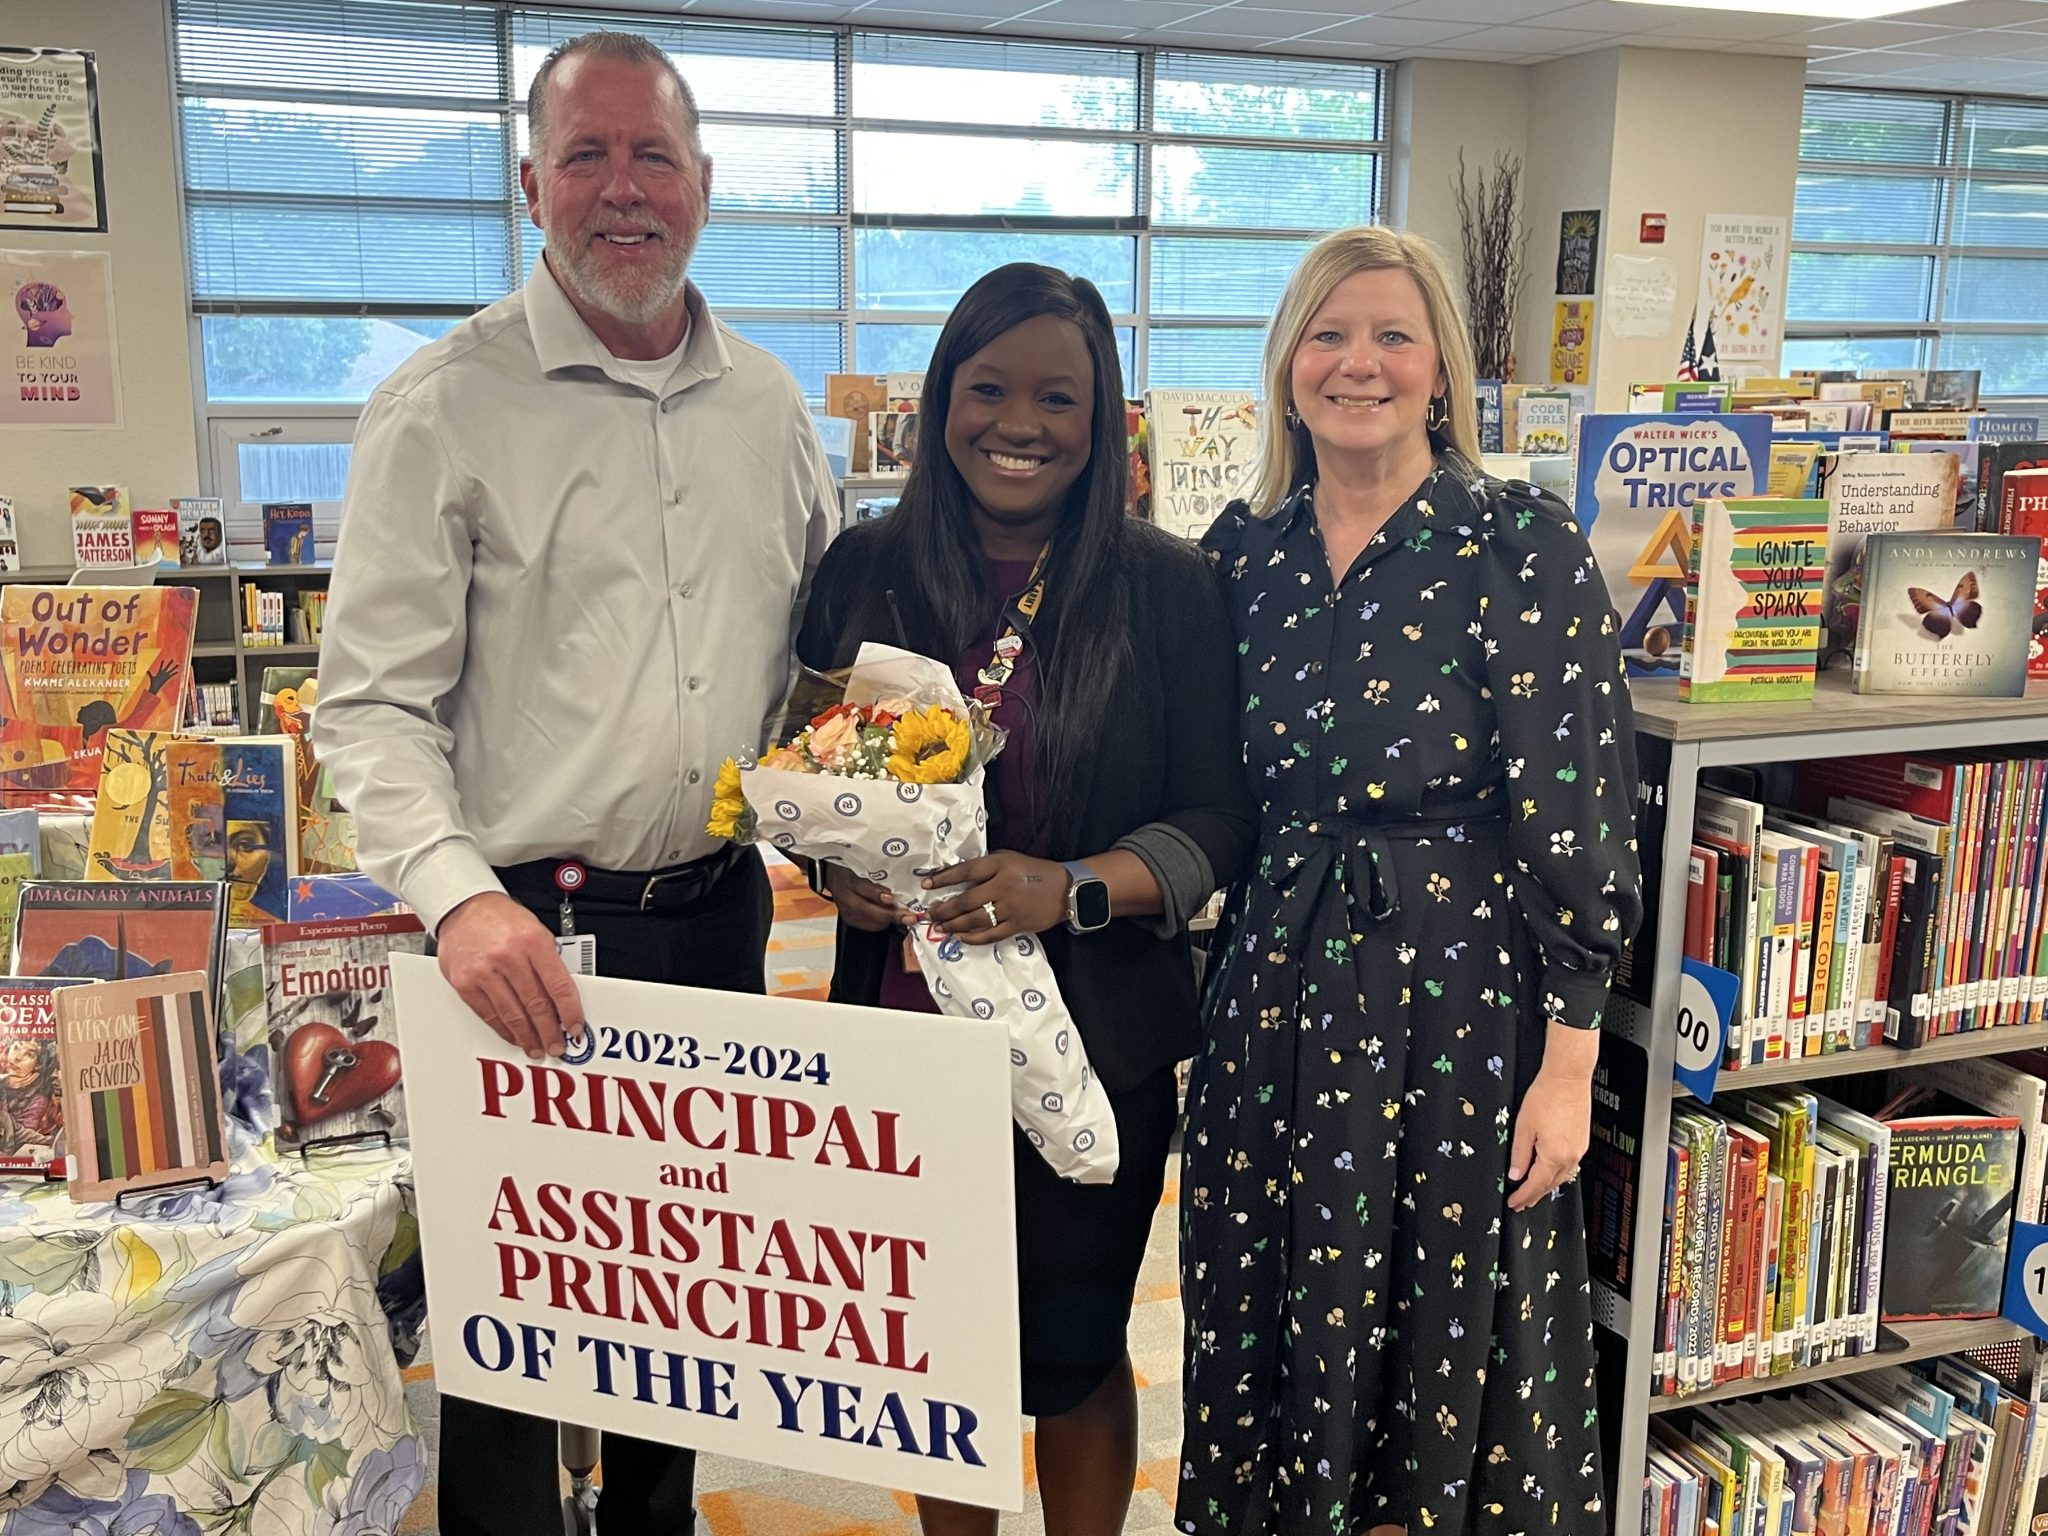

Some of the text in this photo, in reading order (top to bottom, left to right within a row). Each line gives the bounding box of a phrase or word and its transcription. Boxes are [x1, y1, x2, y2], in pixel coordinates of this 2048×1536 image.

[25, 69, 68, 79] gives us
[43, 77, 70, 88] to go
[11, 83, 69, 94] we have to
[37, 92, 53, 100] we
[1563, 272, 1589, 293] DAY
[16, 355, 77, 370] BE KIND
[1555, 350, 1584, 369] SHARE
[17, 372, 79, 383] TO YOUR
[20, 386, 81, 401] MIND
[1163, 391, 1252, 404] DAVID MACAULAY
[1531, 404, 1564, 414] CODE
[1182, 405, 1235, 436] THE
[1527, 415, 1567, 424] GIRLS
[1979, 420, 2033, 433] HOMER'S
[1634, 430, 1718, 439] WALTER WICK'S
[1174, 433, 1238, 461] WAY
[1609, 442, 1747, 473] OPTICAL
[1623, 478, 1736, 508] TRICKS
[1841, 483, 1941, 499] Understanding
[1840, 500, 1914, 515] Health and
[1838, 520, 1899, 533] Behavior
[77, 532, 130, 547] JAMES
[78, 548, 131, 562] PATTERSON
[1890, 549, 2027, 559] ANDY ANDREWS
[1762, 567, 1804, 592] YOUR
[32, 592, 141, 624] Out of
[1753, 592, 1808, 620] SPARK
[19, 627, 149, 657] Wonder
[1734, 629, 1812, 638] DISCOVERING WHO YOU ARE
[1742, 639, 1757, 647] FROM
[20, 660, 137, 675] POEMS CELEBRATING POETS
[1894, 653, 1996, 666] BUTTERFLY
[1776, 675, 1803, 684] WOOSTER
[1911, 668, 1976, 678] EFFECT
[24, 677, 131, 688] KWAME ALEXANDER
[74, 747, 102, 760] EKUA
[1845, 854, 1856, 874] BUILD
[1778, 863, 1789, 909] PARA TODOS
[1785, 855, 1796, 916] COMPUTADORAS
[1843, 874, 1853, 891] YOUR
[1889, 871, 1901, 907] LIBRARY
[28, 889, 214, 903] IMAGINARY ANIMALS
[1841, 891, 1852, 906] OWN
[300, 921, 388, 937] Experiencing Poetry
[1814, 889, 1835, 992] GIRL CODE
[1923, 913, 1935, 968] FRIGHTLOPEDIA
[281, 946, 332, 959] Poems About
[0, 994, 53, 1006] CLASSI
[74, 995, 103, 1018] FOR
[94, 1037, 139, 1065] JASON
[600, 1027, 831, 1086] 2023-2024
[80, 1060, 141, 1091] REYNOLDS
[476, 1057, 921, 1178] PRINCIPAL
[1612, 1124, 1636, 1156] Law
[659, 1162, 730, 1194] and
[1892, 1164, 2003, 1188] RIANGLE
[1671, 1161, 1688, 1293] BIG QUESTIONS
[1704, 1135, 1725, 1328] GUINNESS WORLD RECORDS
[1725, 1218, 1734, 1243] How
[1867, 1172, 1886, 1298] QUOTATIONS FOR KIDS
[488, 1175, 926, 1300] ASSISTANT
[1688, 1151, 1709, 1355] GUINNESS WORLD RECORDS 2022
[1723, 1245, 1731, 1256] to
[1721, 1259, 1730, 1284] Hold
[494, 1242, 929, 1374] PRINCIPAL
[463, 1314, 986, 1467] OF THE YEAR
[1907, 1481, 1915, 1492] THE
[1904, 1494, 1912, 1512] LITTLE
